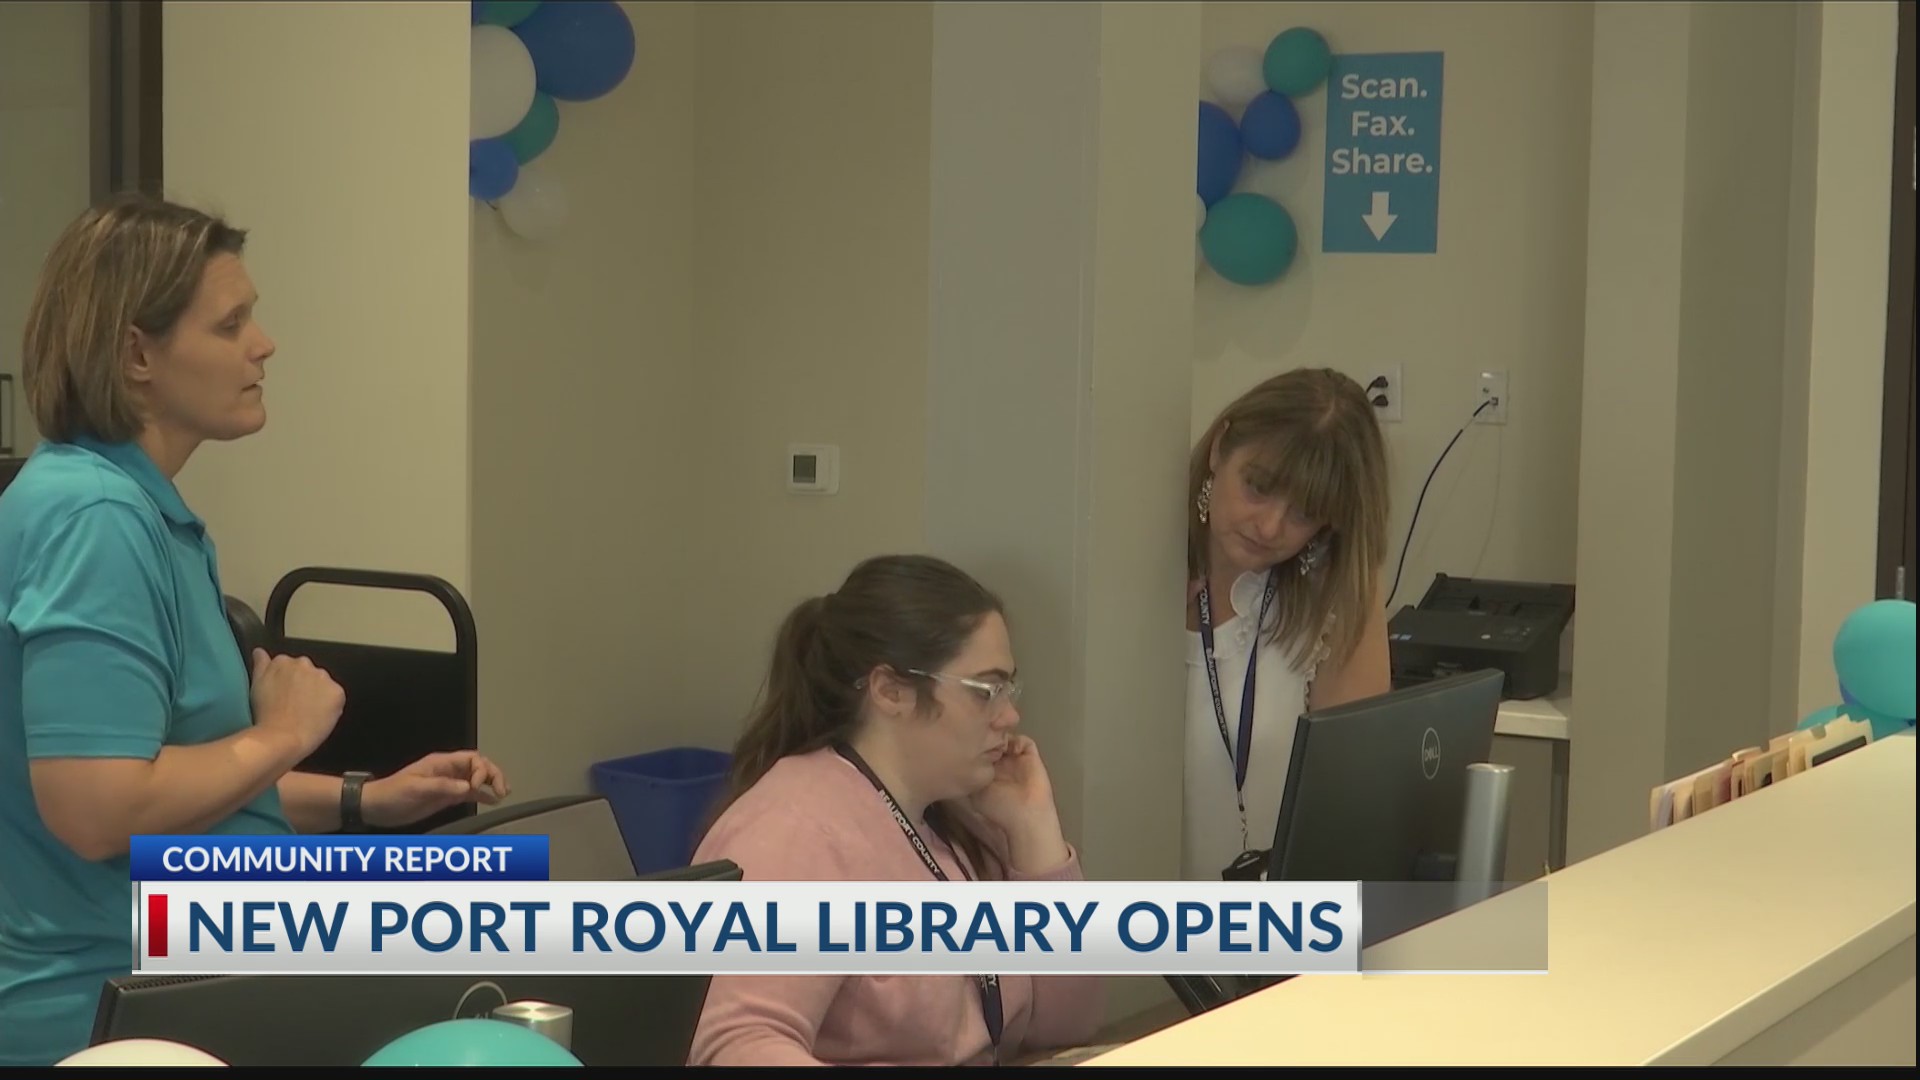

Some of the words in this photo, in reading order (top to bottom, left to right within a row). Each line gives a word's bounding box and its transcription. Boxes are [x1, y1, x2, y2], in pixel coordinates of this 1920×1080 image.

[1341, 73, 1428, 100] Scan.
[1351, 110, 1415, 137] Fax.
[1331, 147, 1433, 175] Share.
[878, 789, 914, 837] BEAUFORT
[911, 836, 940, 874] COUNTY
